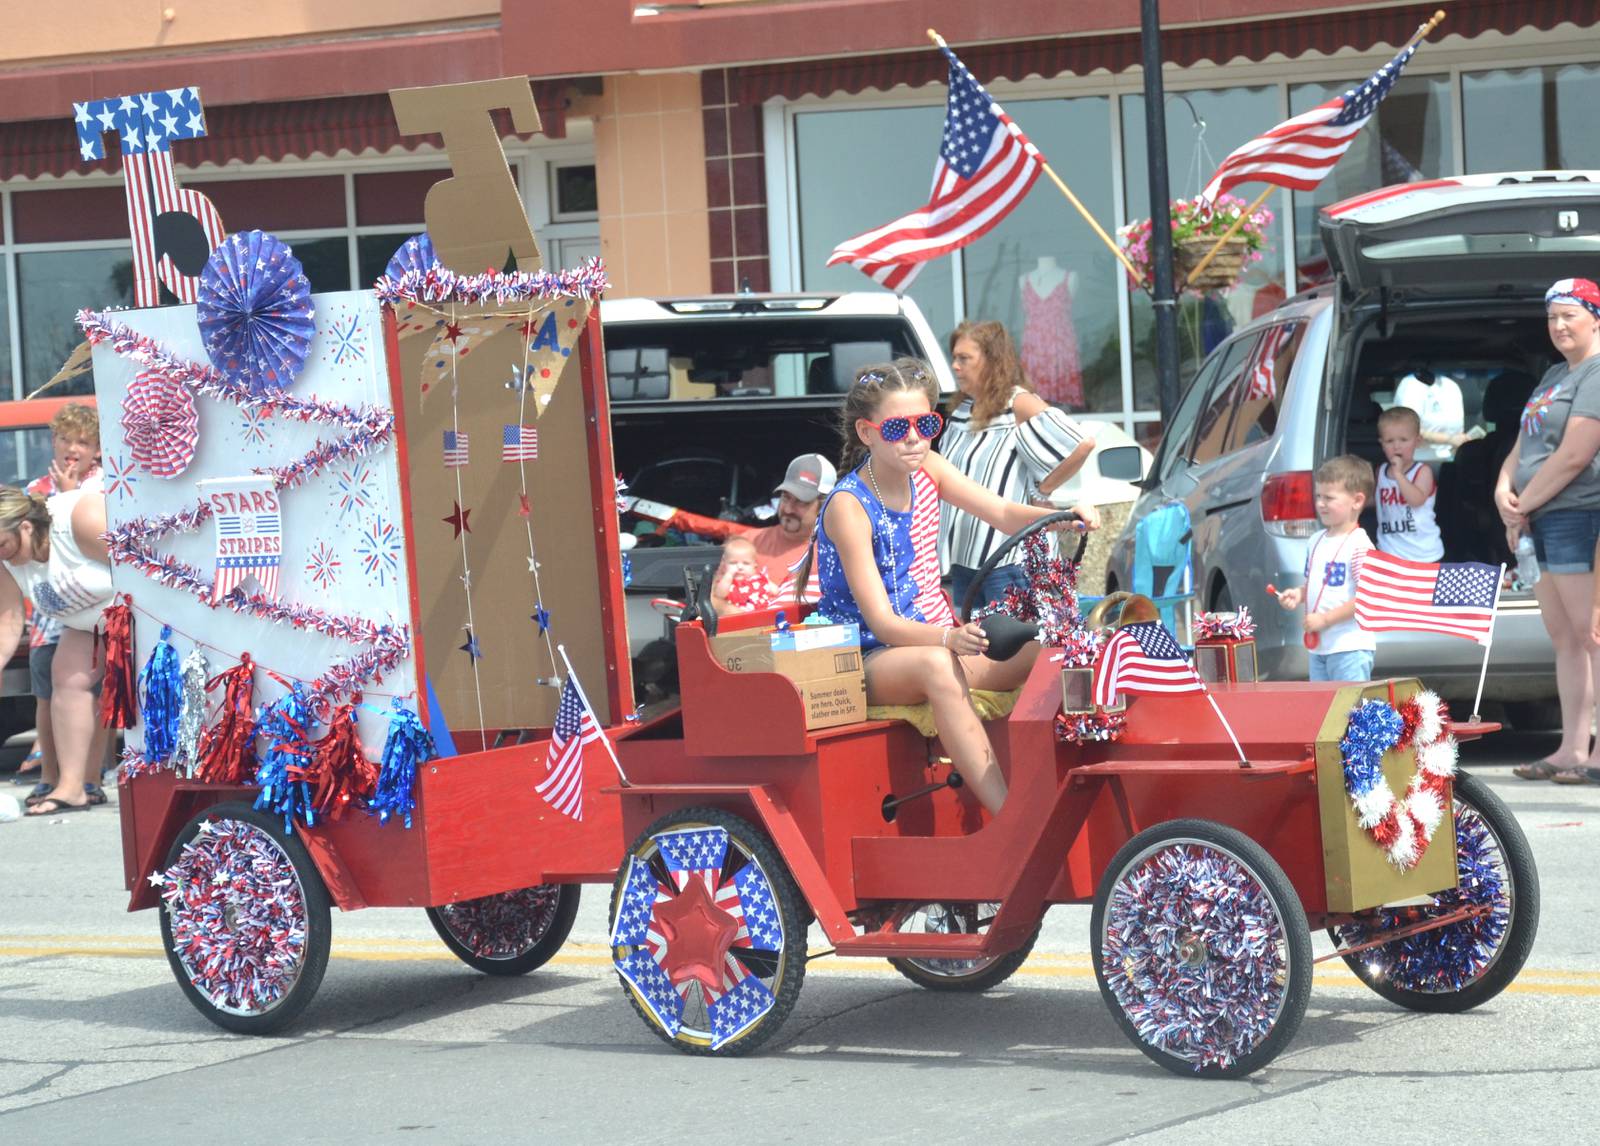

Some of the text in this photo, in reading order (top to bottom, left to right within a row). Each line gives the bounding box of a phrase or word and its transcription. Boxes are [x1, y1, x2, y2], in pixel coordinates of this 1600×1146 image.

[211, 490, 278, 514] STARS
[1381, 520, 1417, 534] BLUE
[219, 536, 280, 555] STRIPES
[810, 688, 848, 701] Summer deals
[811, 696, 852, 711] are here. Quick,
[811, 711, 830, 720] slather
